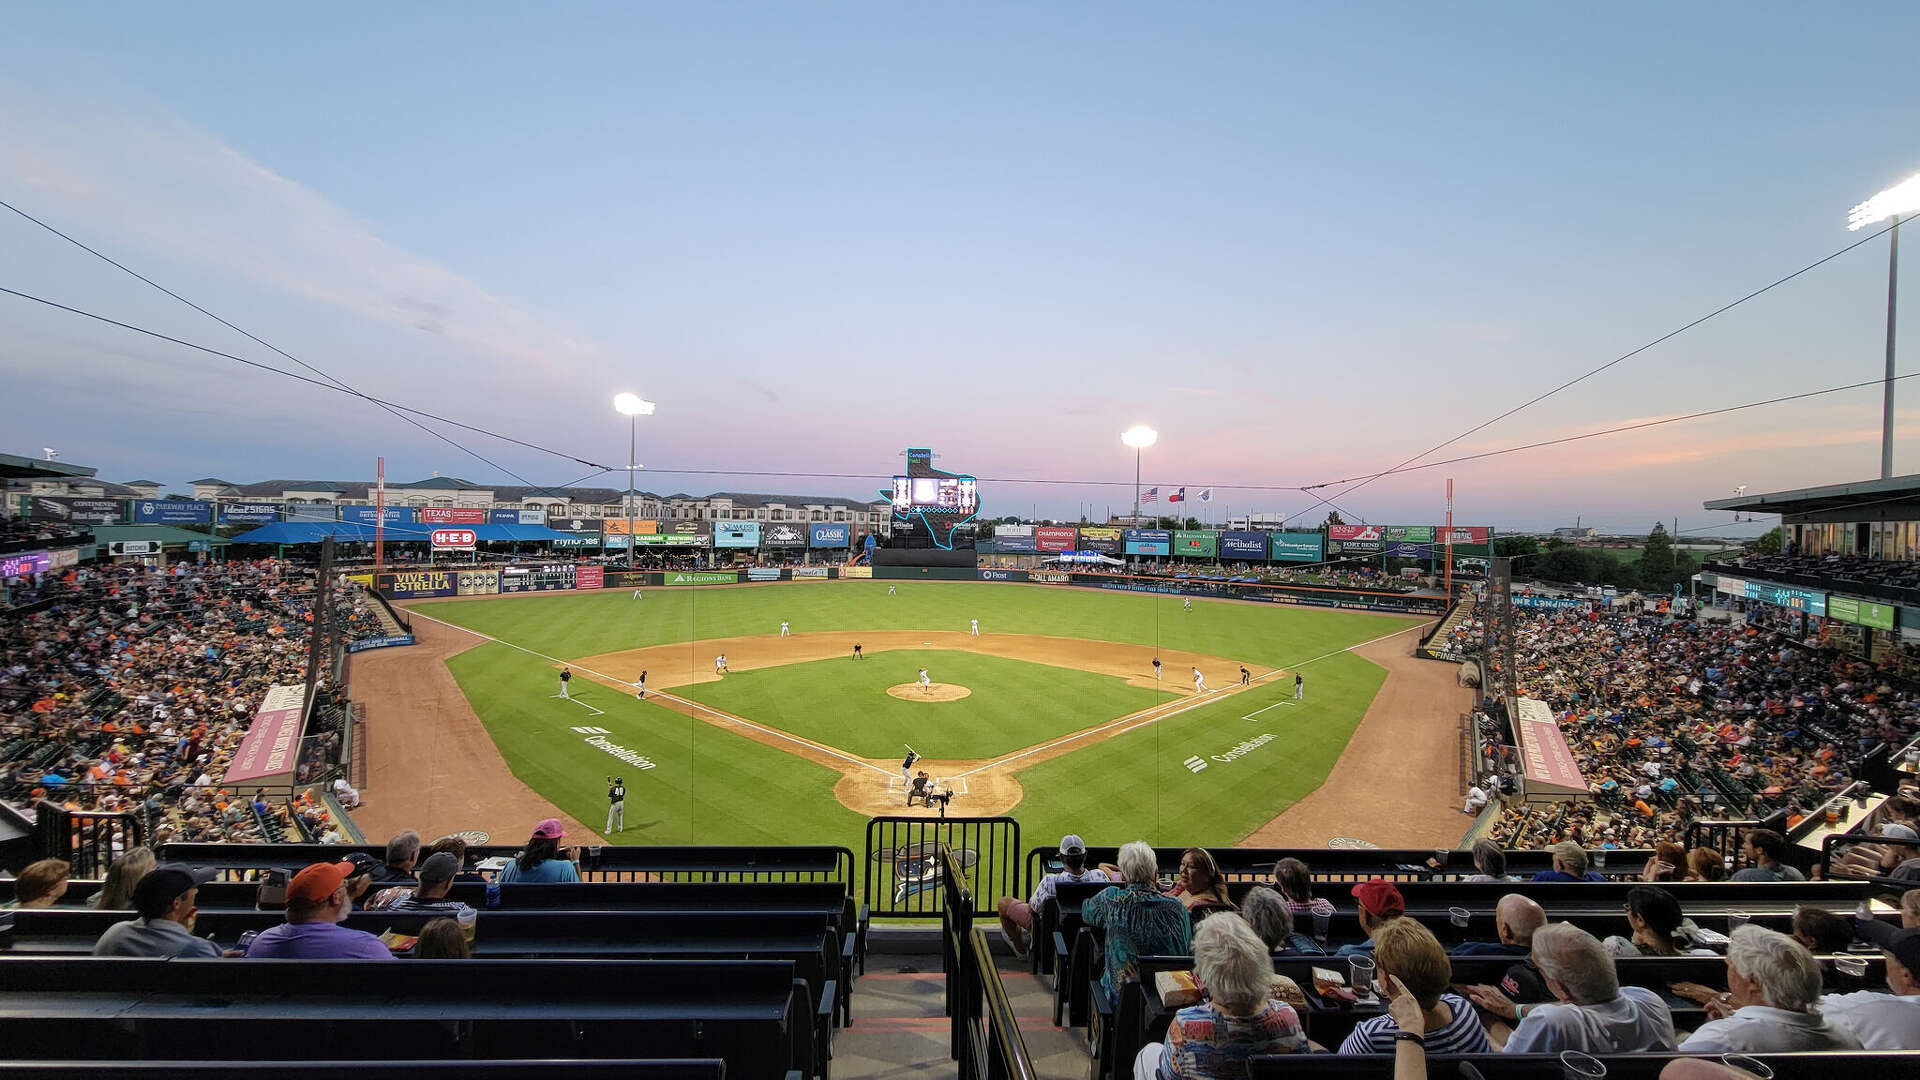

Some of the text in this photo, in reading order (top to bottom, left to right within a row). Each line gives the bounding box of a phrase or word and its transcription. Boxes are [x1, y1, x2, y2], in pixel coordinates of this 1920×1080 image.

[425, 509, 452, 517] TEXAS
[816, 528, 843, 540] CLASSIC
[1225, 540, 1262, 549] Methodist
[397, 573, 443, 582] VIVE TU
[394, 581, 450, 592] ESTRELLA
[584, 735, 657, 770] Constellation
